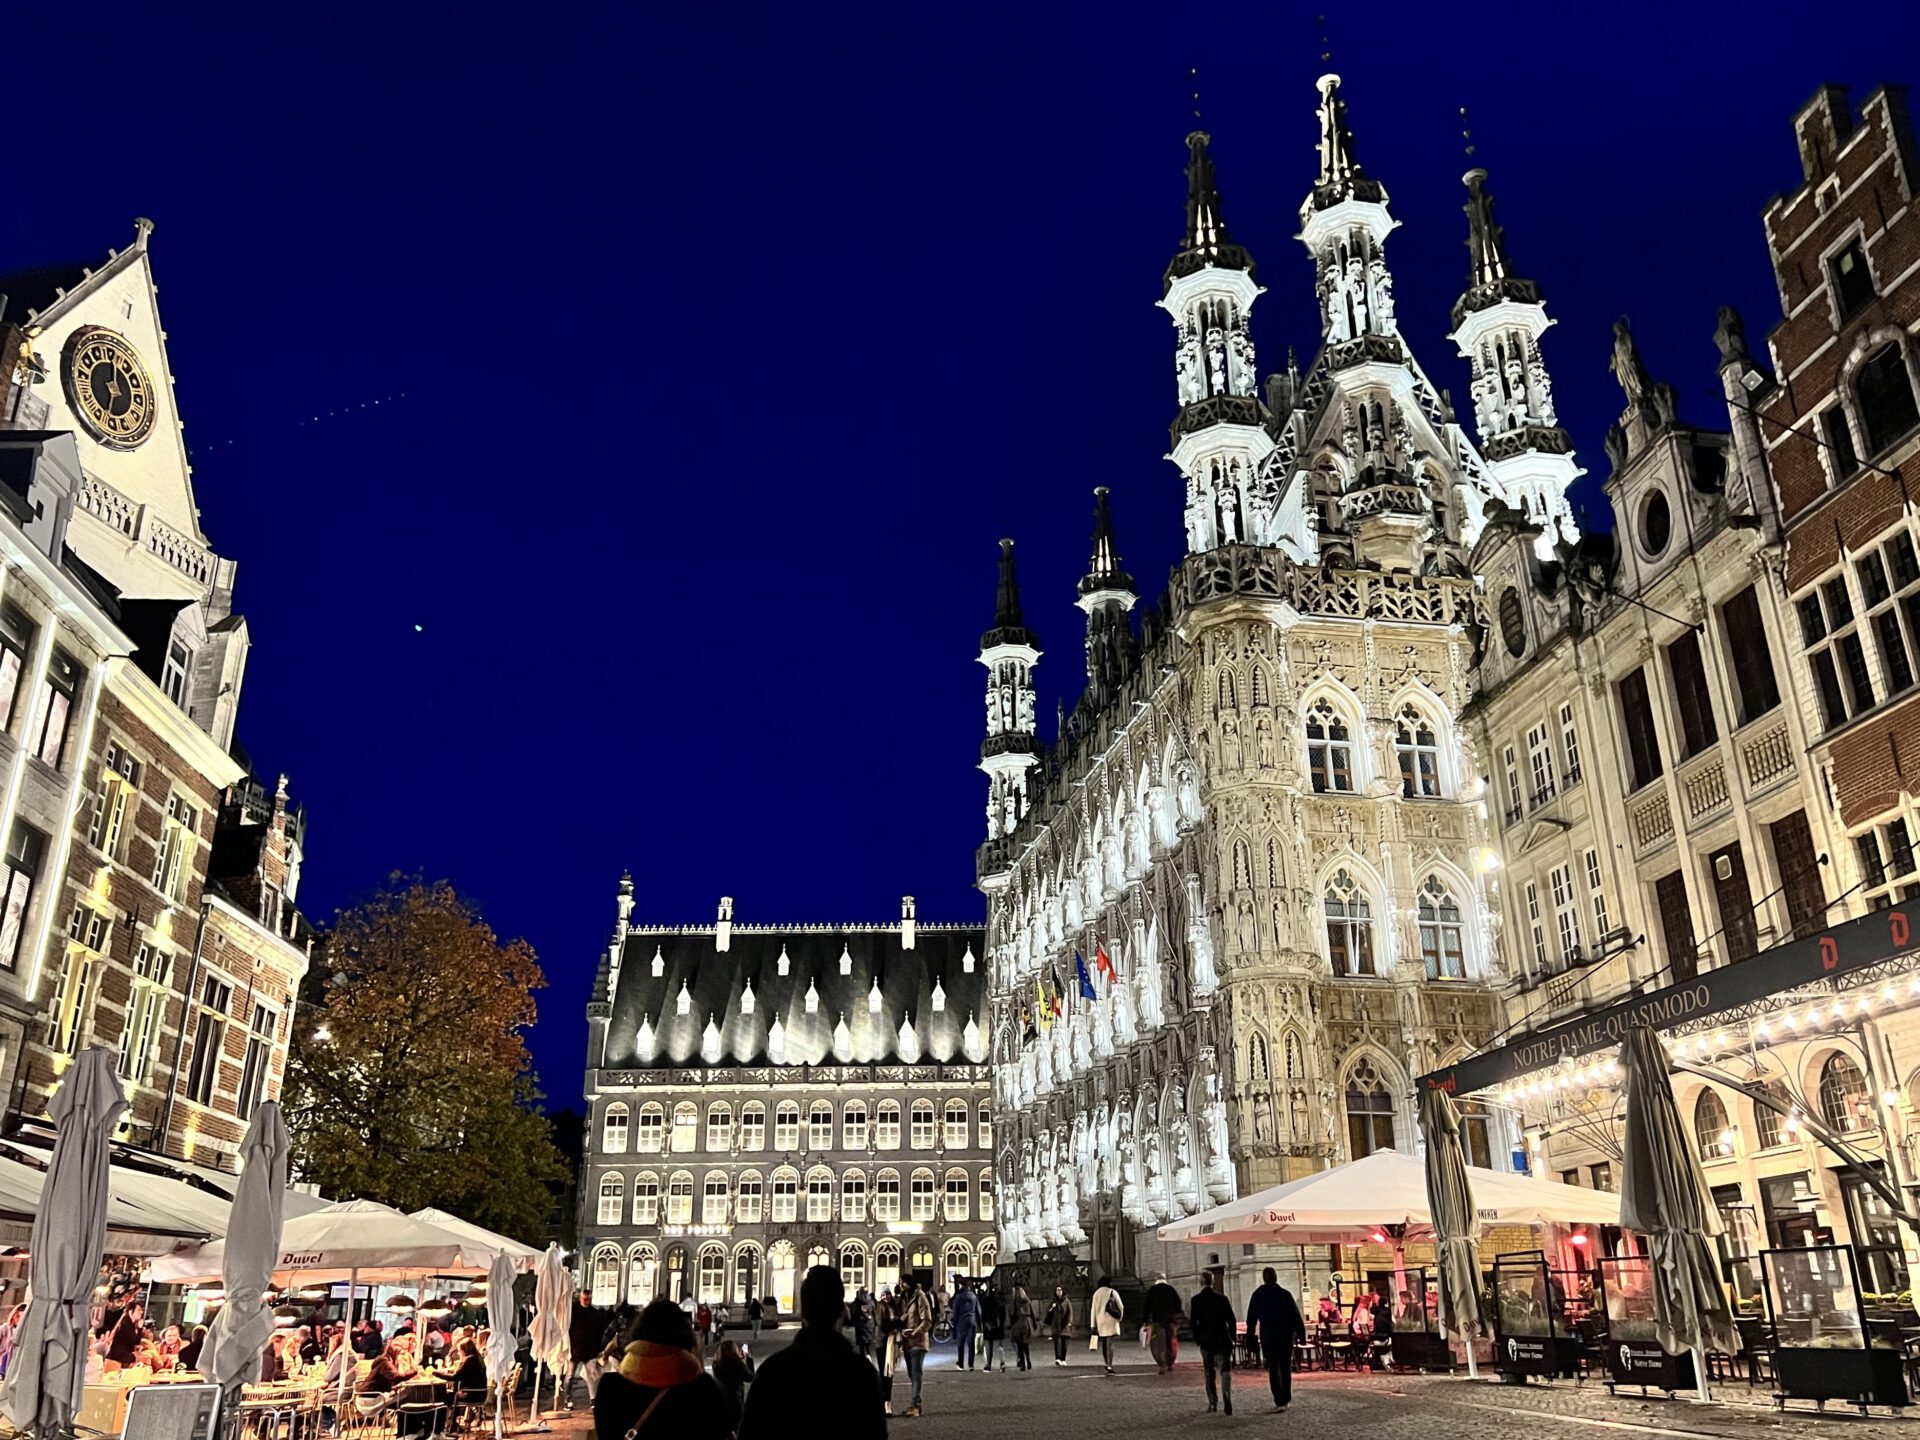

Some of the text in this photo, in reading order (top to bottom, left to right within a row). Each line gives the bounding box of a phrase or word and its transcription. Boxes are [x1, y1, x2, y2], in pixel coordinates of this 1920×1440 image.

[1513, 984, 1711, 1070] NOTRE DAME-QUASIMODO
[1269, 1211, 1296, 1222] Duvel
[282, 1252, 323, 1264] Duvel
